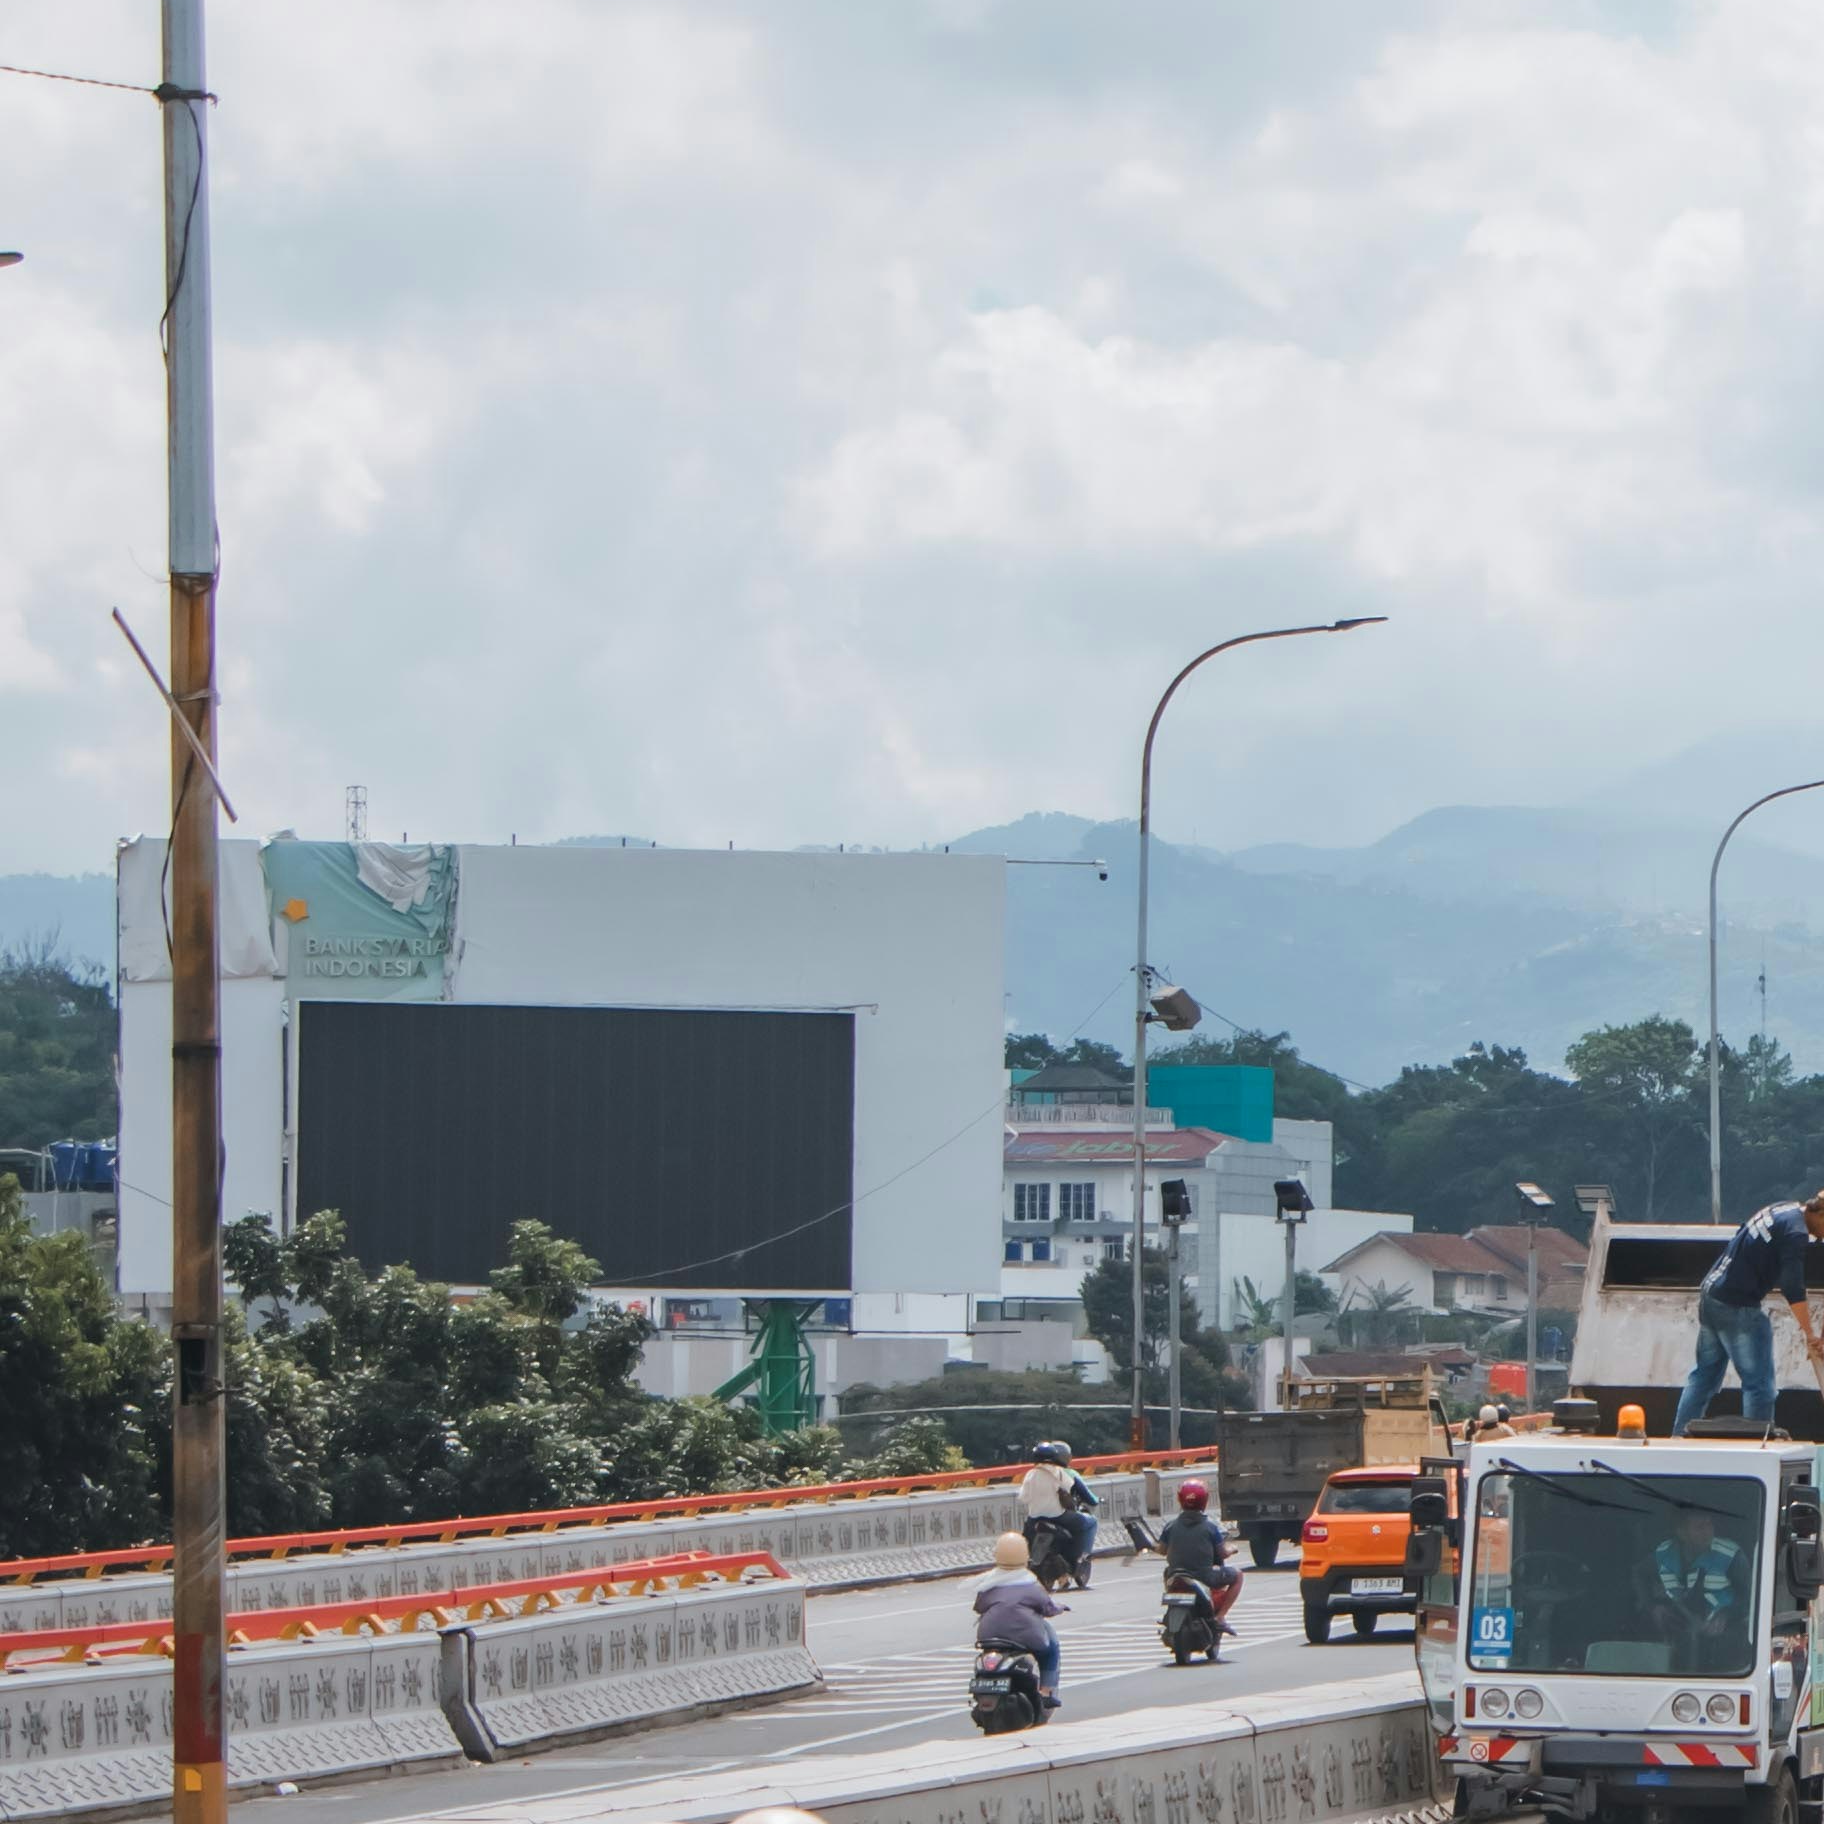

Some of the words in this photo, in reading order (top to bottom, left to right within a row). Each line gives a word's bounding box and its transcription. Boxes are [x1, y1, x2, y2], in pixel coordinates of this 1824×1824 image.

[306, 938, 368, 955] BANK
[306, 960, 427, 977] INDONESIA
[1480, 1615, 1507, 1641] 03
